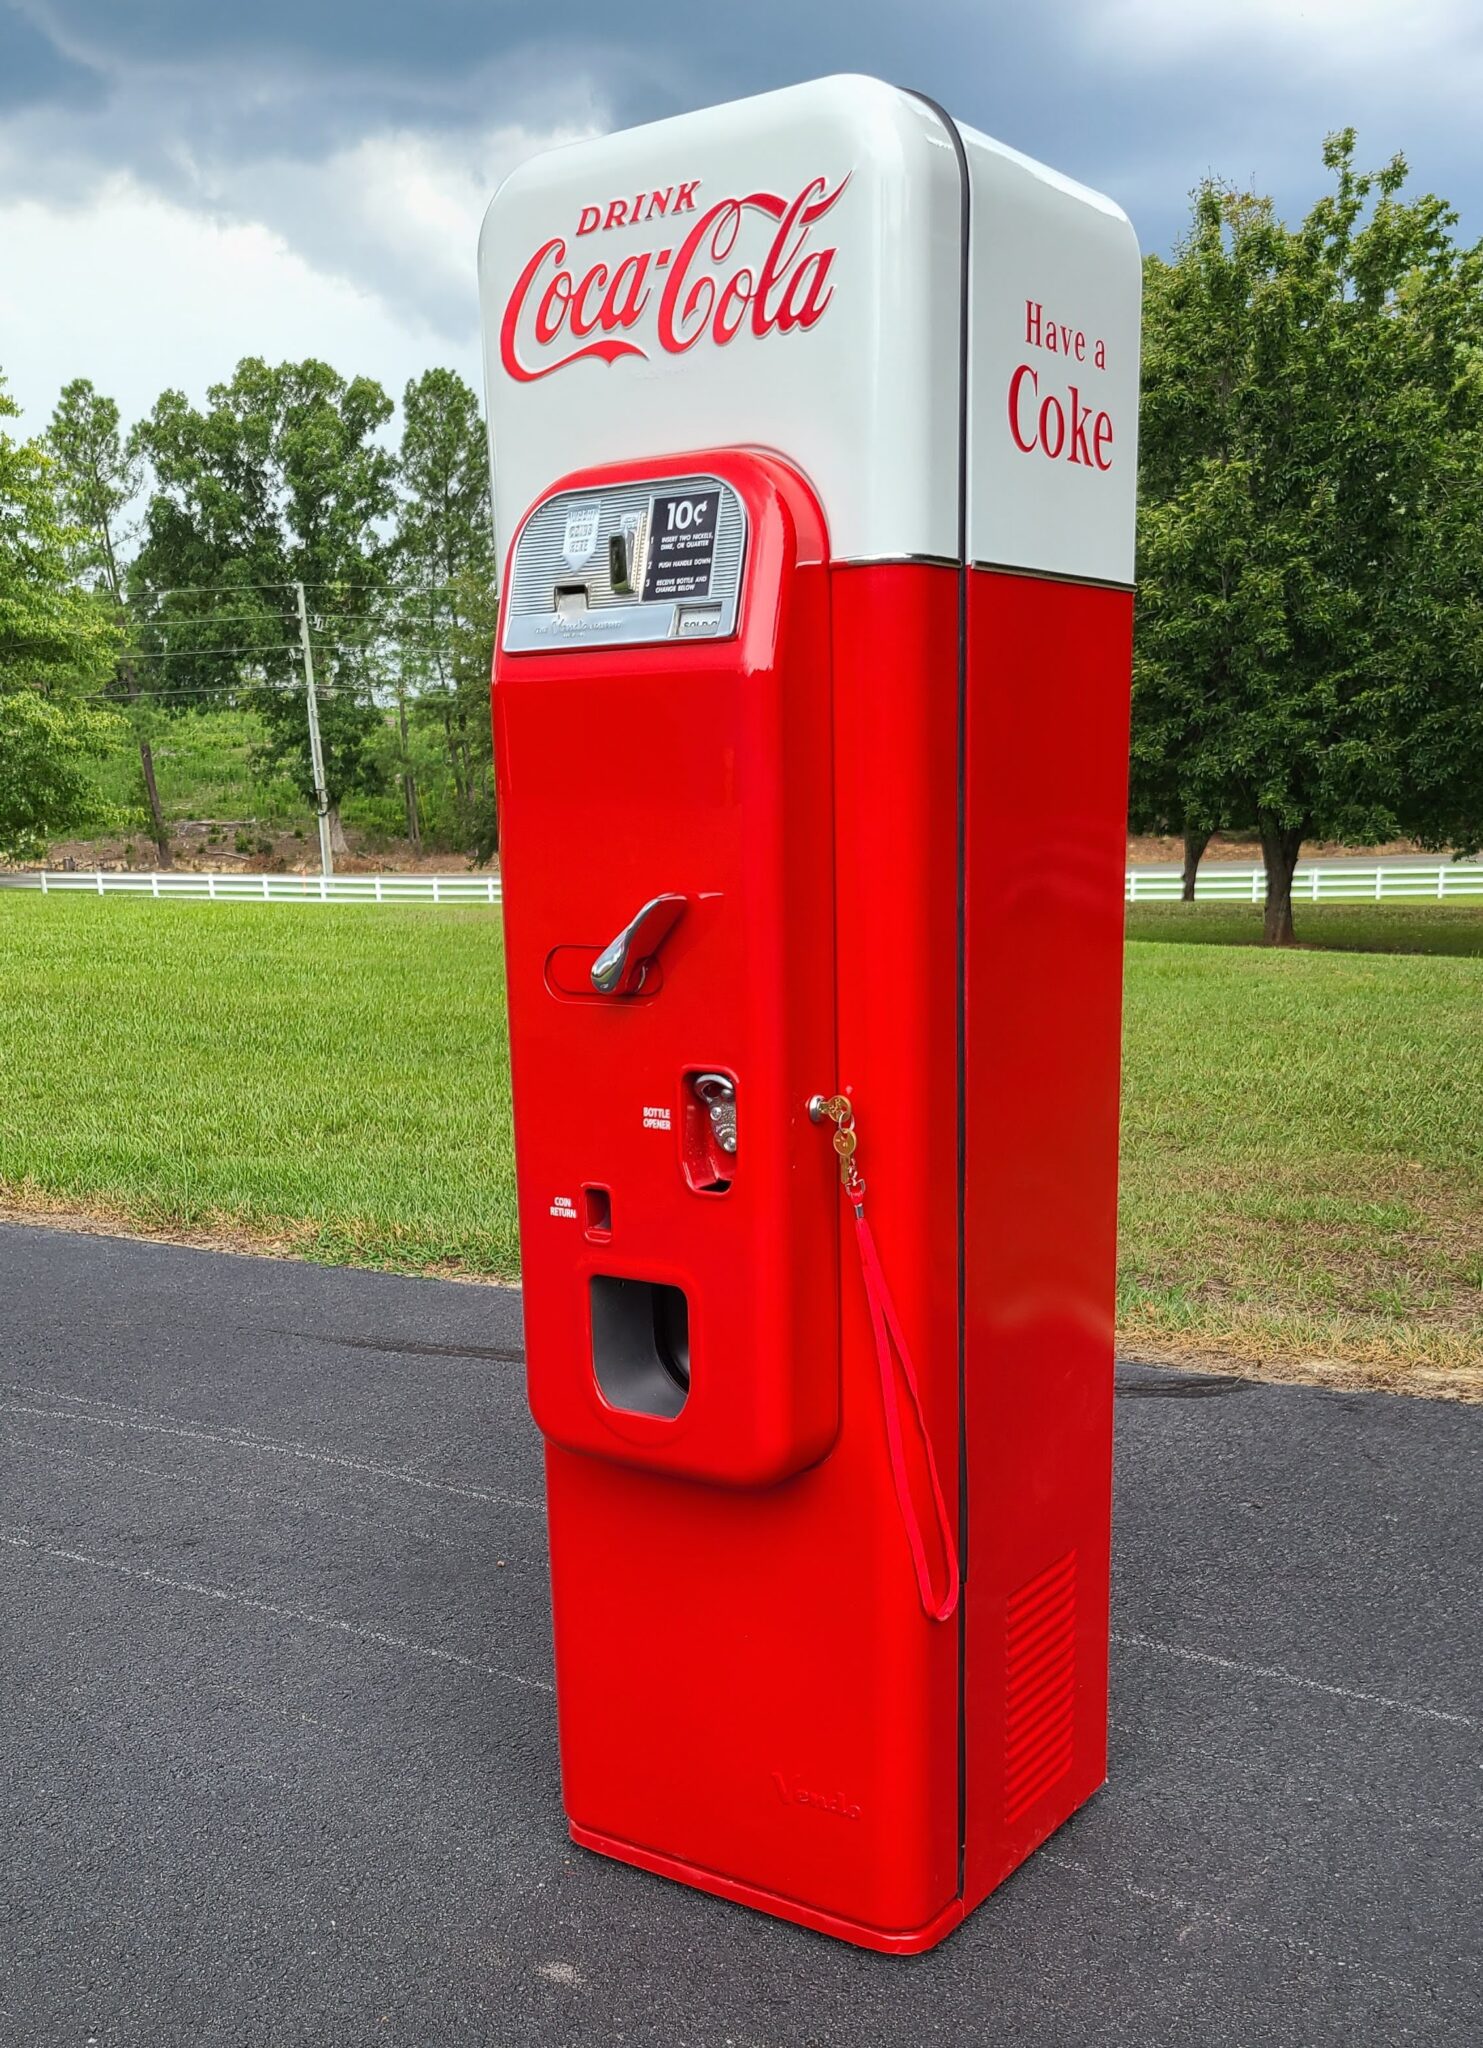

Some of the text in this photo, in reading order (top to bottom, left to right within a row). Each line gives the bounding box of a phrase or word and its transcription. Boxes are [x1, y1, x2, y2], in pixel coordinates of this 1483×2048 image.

[575, 179, 702, 237] DRINK
[499, 168, 854, 383] Coca-Cola
[1025, 299, 1106, 371] Have a
[1007, 363, 1113, 471] Coke
[666, 500, 708, 531] 10¢
[679, 534, 692, 542] TWO
[676, 542, 686, 550] OR
[686, 540, 709, 548] QUARTER
[658, 561, 672, 569] PUSH
[672, 559, 693, 568] HANDLE
[676, 576, 694, 584] BOTTLE
[695, 575, 708, 583] AND
[655, 583, 696, 594] CHANGE BELOW
[643, 1106, 671, 1119] BOTTLE
[643, 1118, 671, 1131] OPENER
[554, 1196, 572, 1207] COIN
[550, 1206, 577, 1219] RETURN
